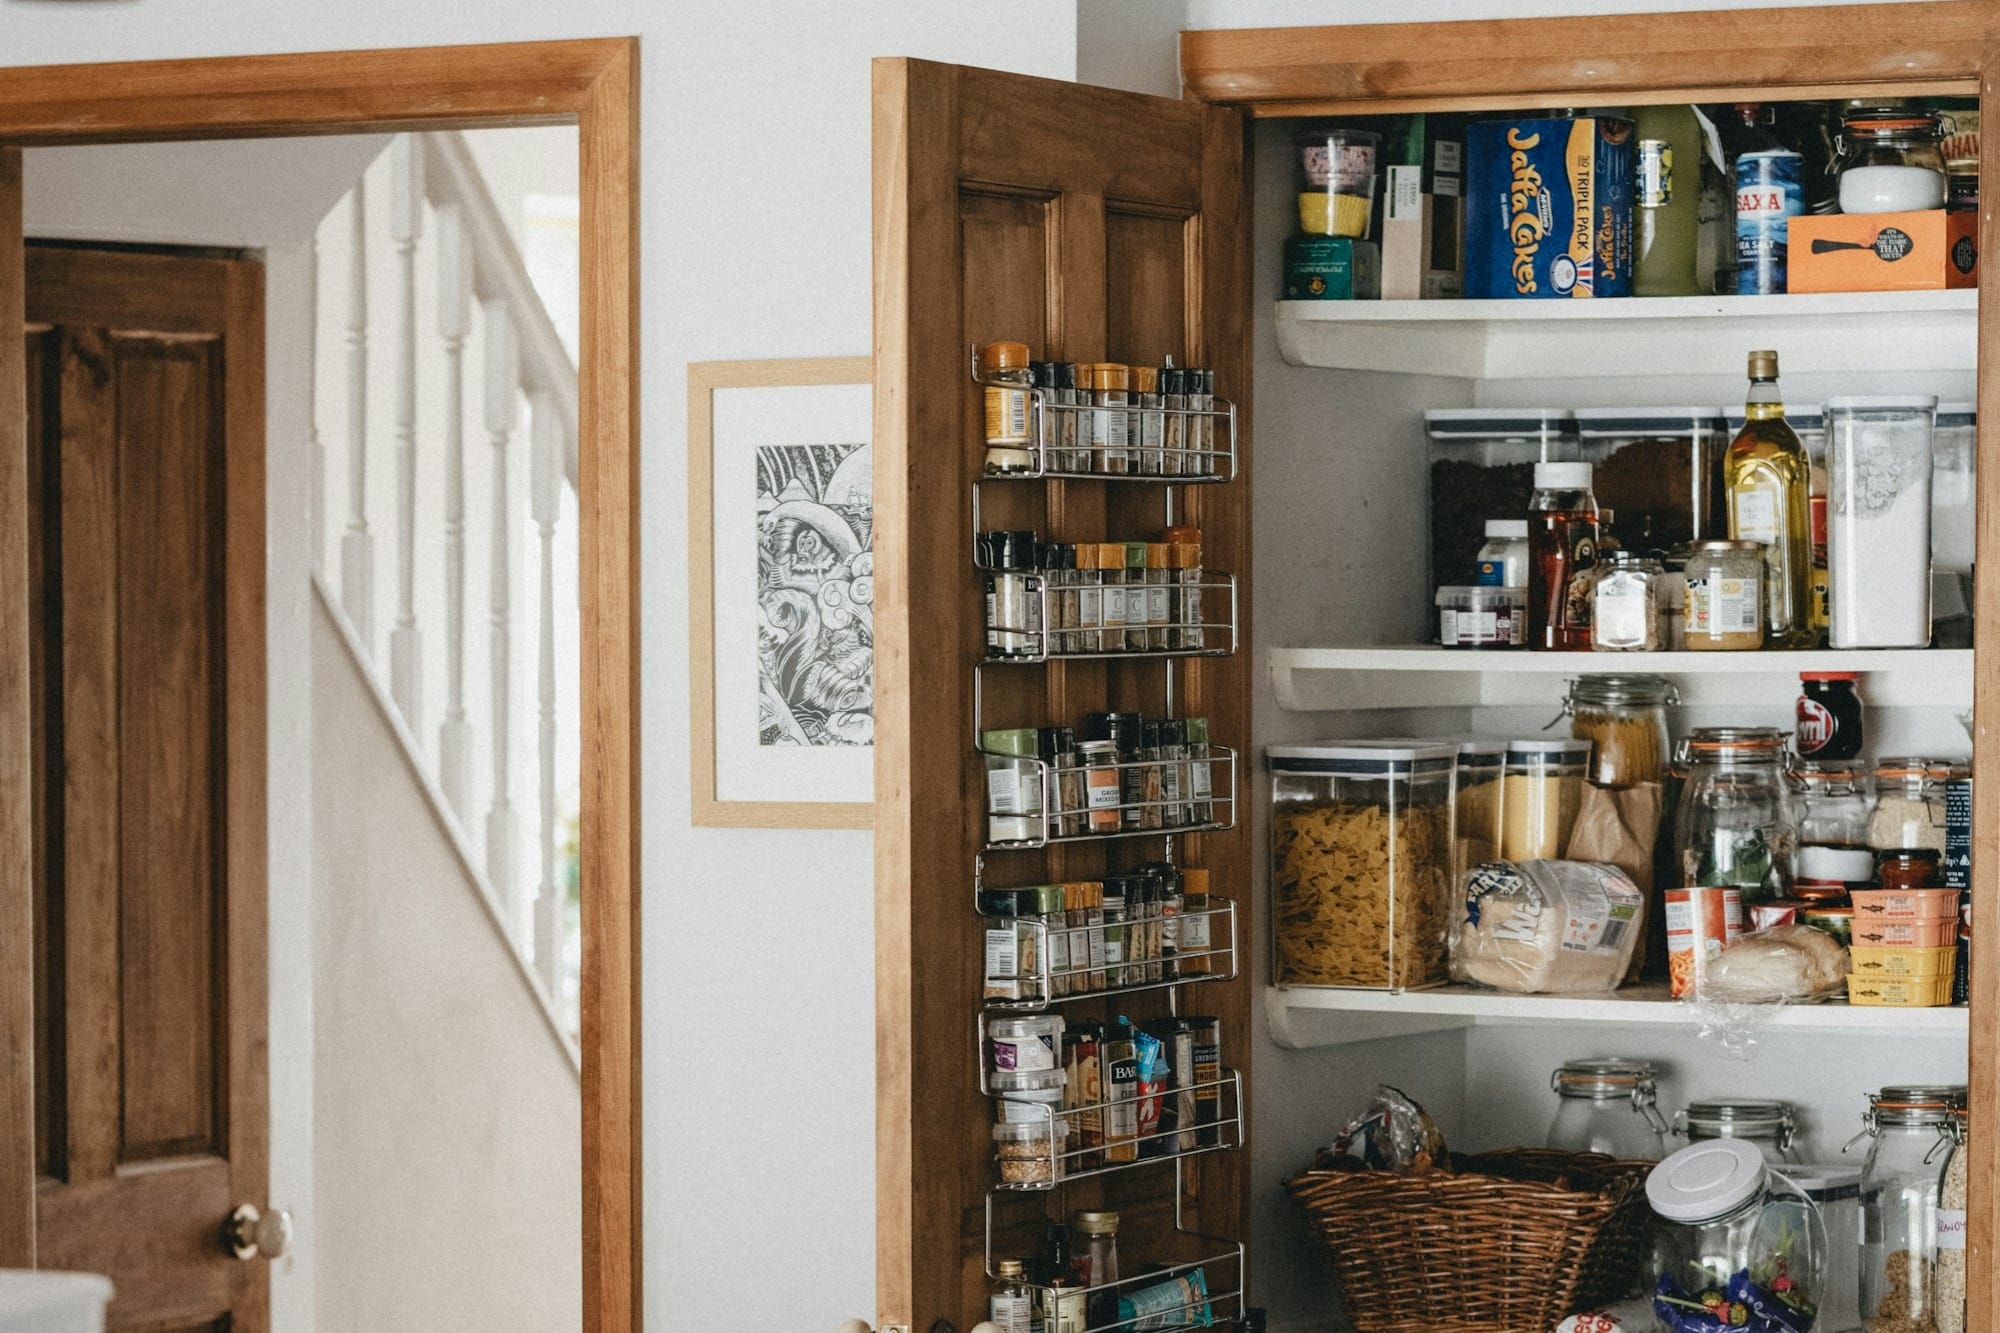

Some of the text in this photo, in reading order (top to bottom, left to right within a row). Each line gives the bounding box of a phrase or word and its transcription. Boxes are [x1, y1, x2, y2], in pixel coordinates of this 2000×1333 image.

[1581, 155, 1590, 168] 30
[1507, 127, 1544, 294] Jaffa Cakes
[1577, 171, 1590, 250] TRIPLE PACK
[1736, 193, 1781, 211] SAXA
[1599, 205, 1616, 281] Jaffa Cakes
[1879, 244, 1904, 253] THAT
[1815, 584, 1826, 593] 10
